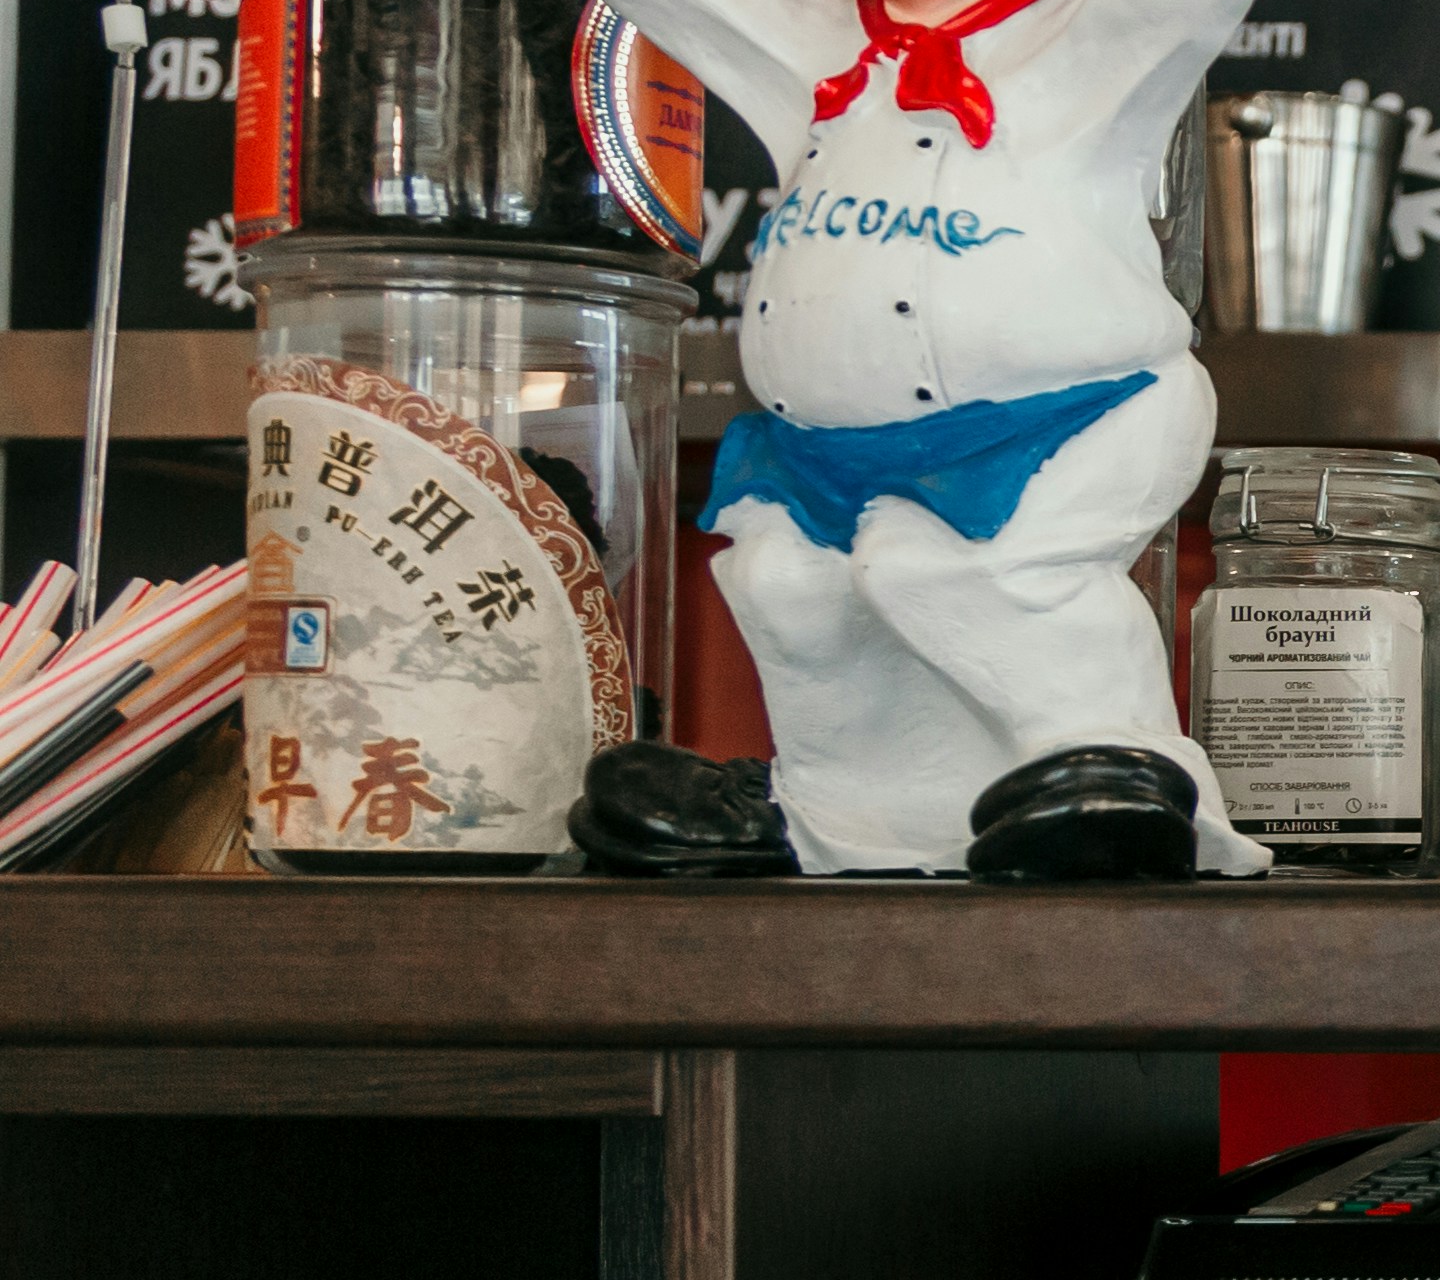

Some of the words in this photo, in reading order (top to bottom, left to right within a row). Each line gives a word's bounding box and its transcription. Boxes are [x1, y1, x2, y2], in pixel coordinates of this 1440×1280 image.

[423, 590, 464, 644] TEA
[1230, 605, 1372, 623] Шоколадний
[1265, 625, 1336, 648] брауні
[1229, 653, 1265, 663] ЧОРНИЙ
[1267, 652, 1351, 663] АРОМАТИЗОВАНИЙ
[256, 734, 452, 842] 早春
[1264, 821, 1340, 832] TEAHOUSE
